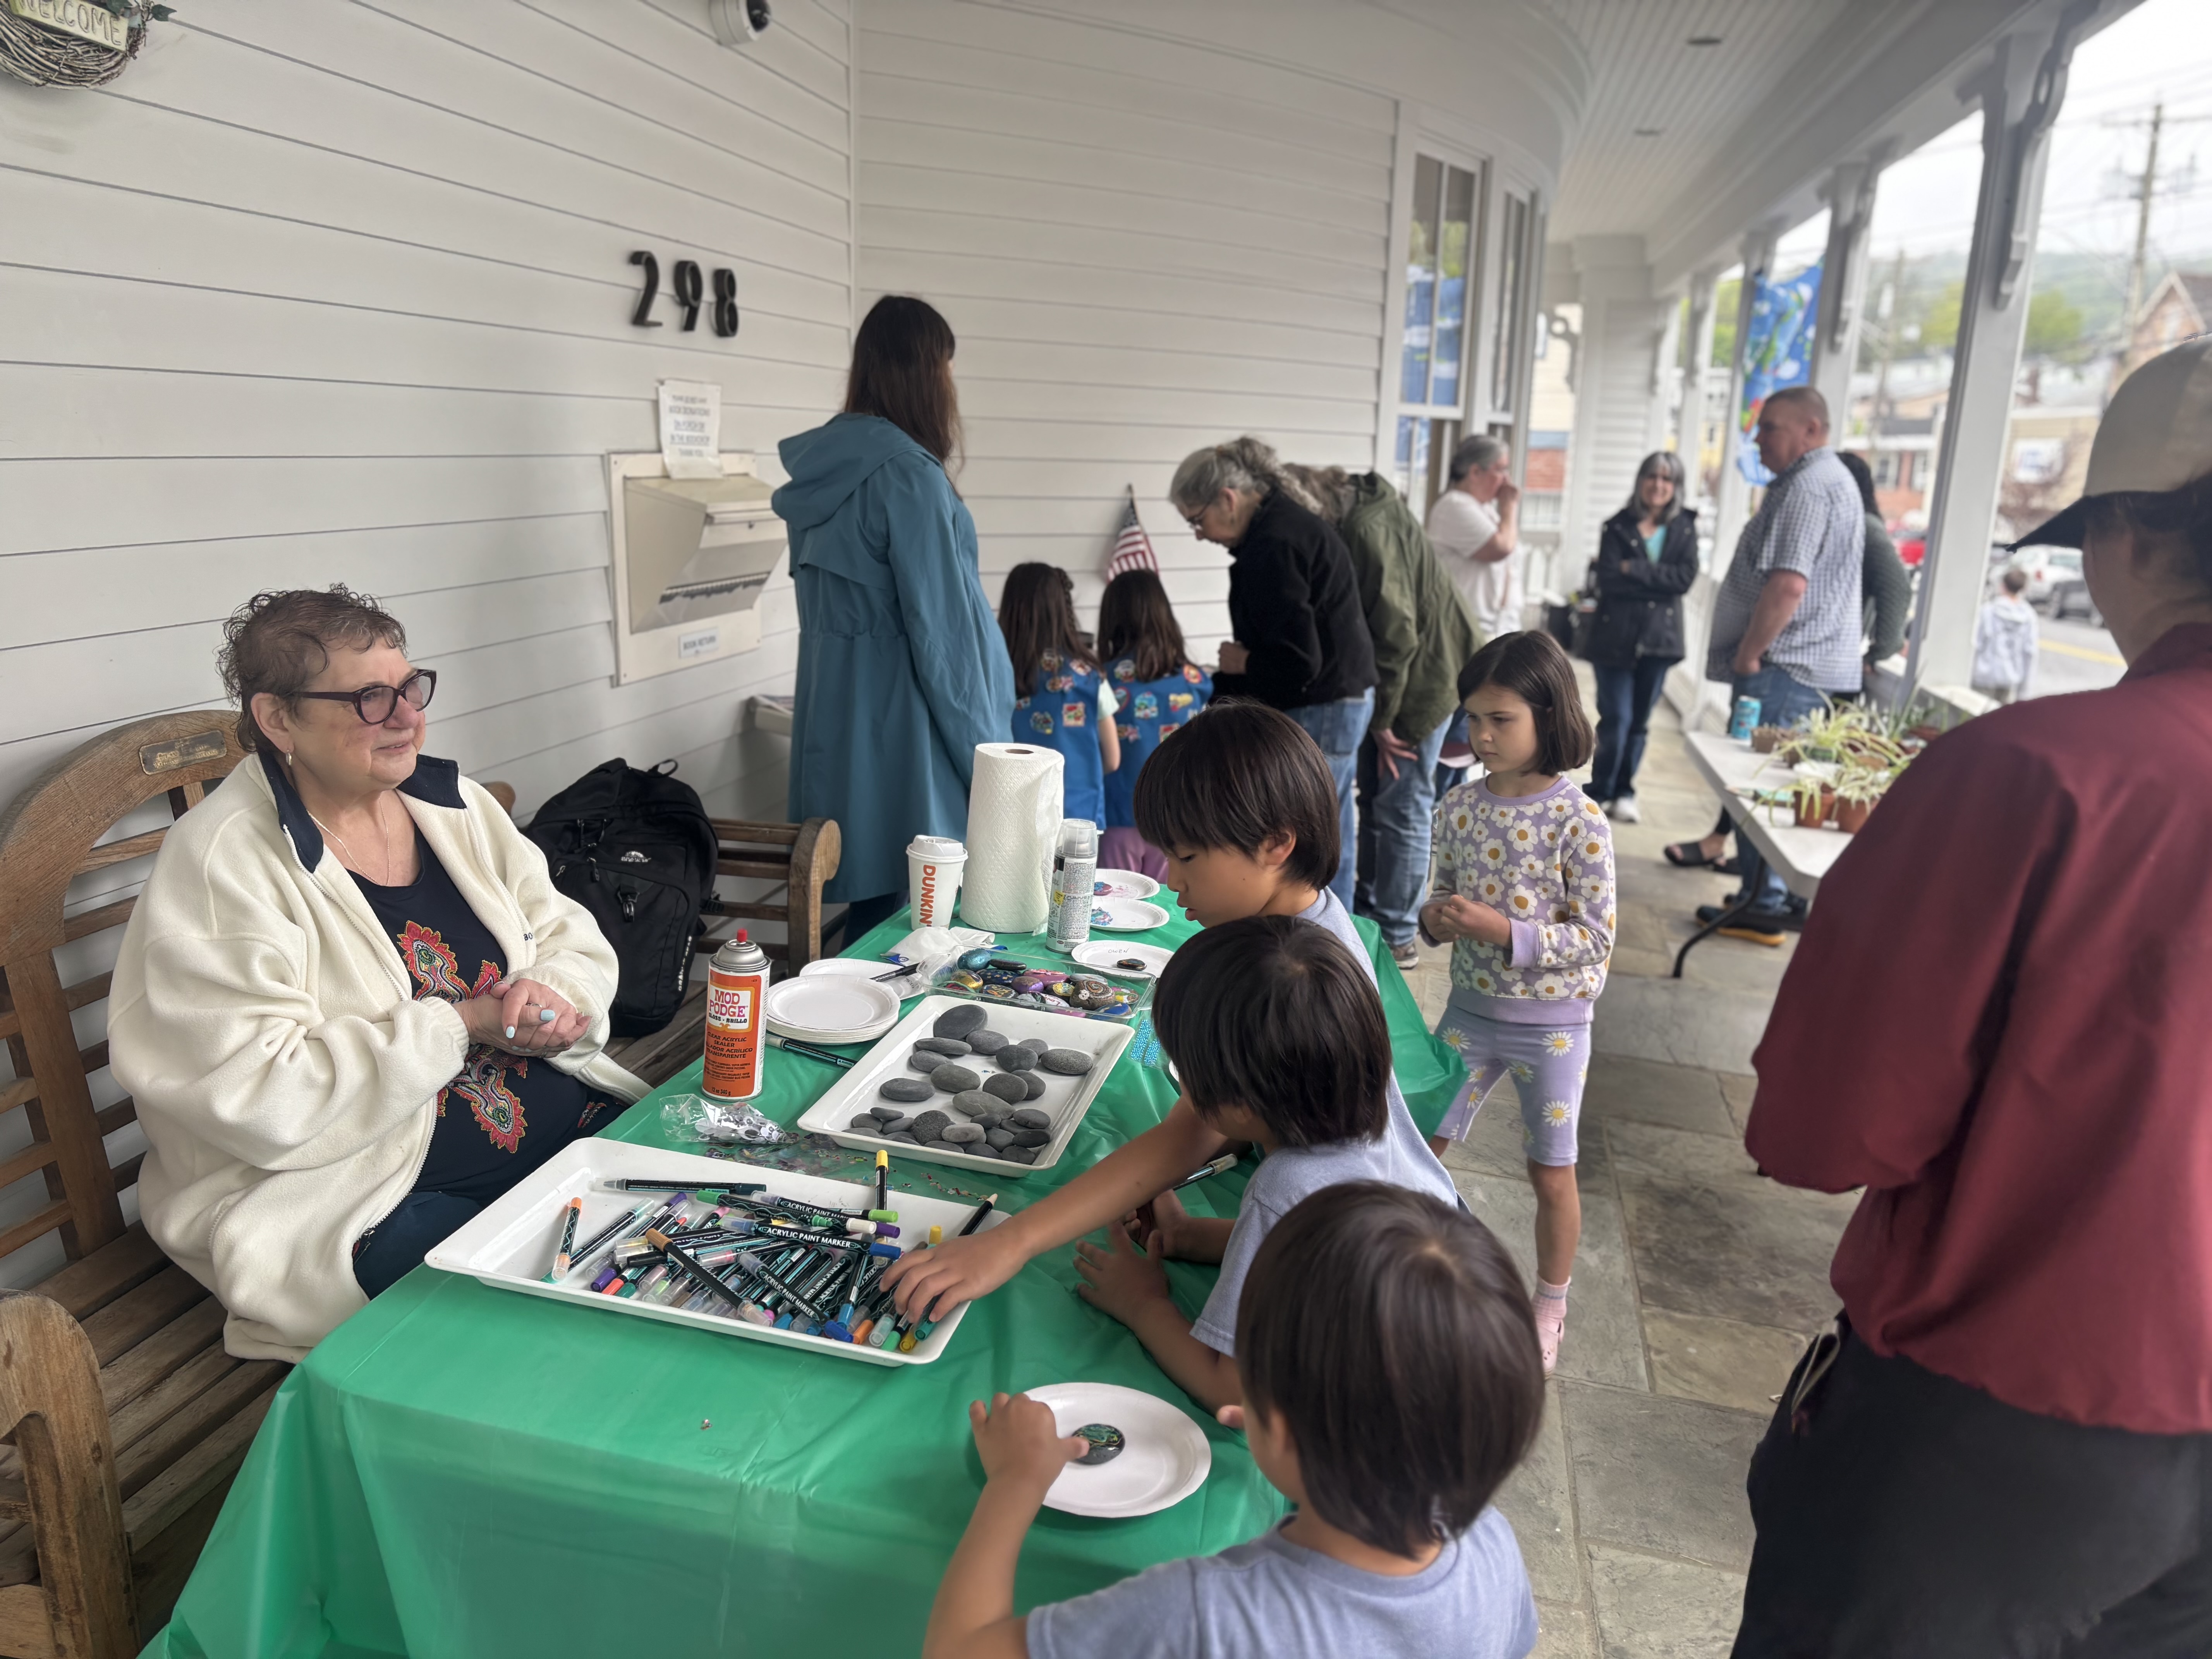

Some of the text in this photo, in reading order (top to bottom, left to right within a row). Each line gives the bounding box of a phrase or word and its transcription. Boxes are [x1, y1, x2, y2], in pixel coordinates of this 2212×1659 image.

[629, 251, 738, 337] 298
[714, 989, 740, 1005] MOD
[709, 999, 746, 1017] PODGE
[787, 1202, 812, 1213] ACRYLIC
[766, 1227, 851, 1248] ACRYLIC PAINT MARKER
[763, 1274, 815, 1318] ACRYLIC PAINT MARKER
